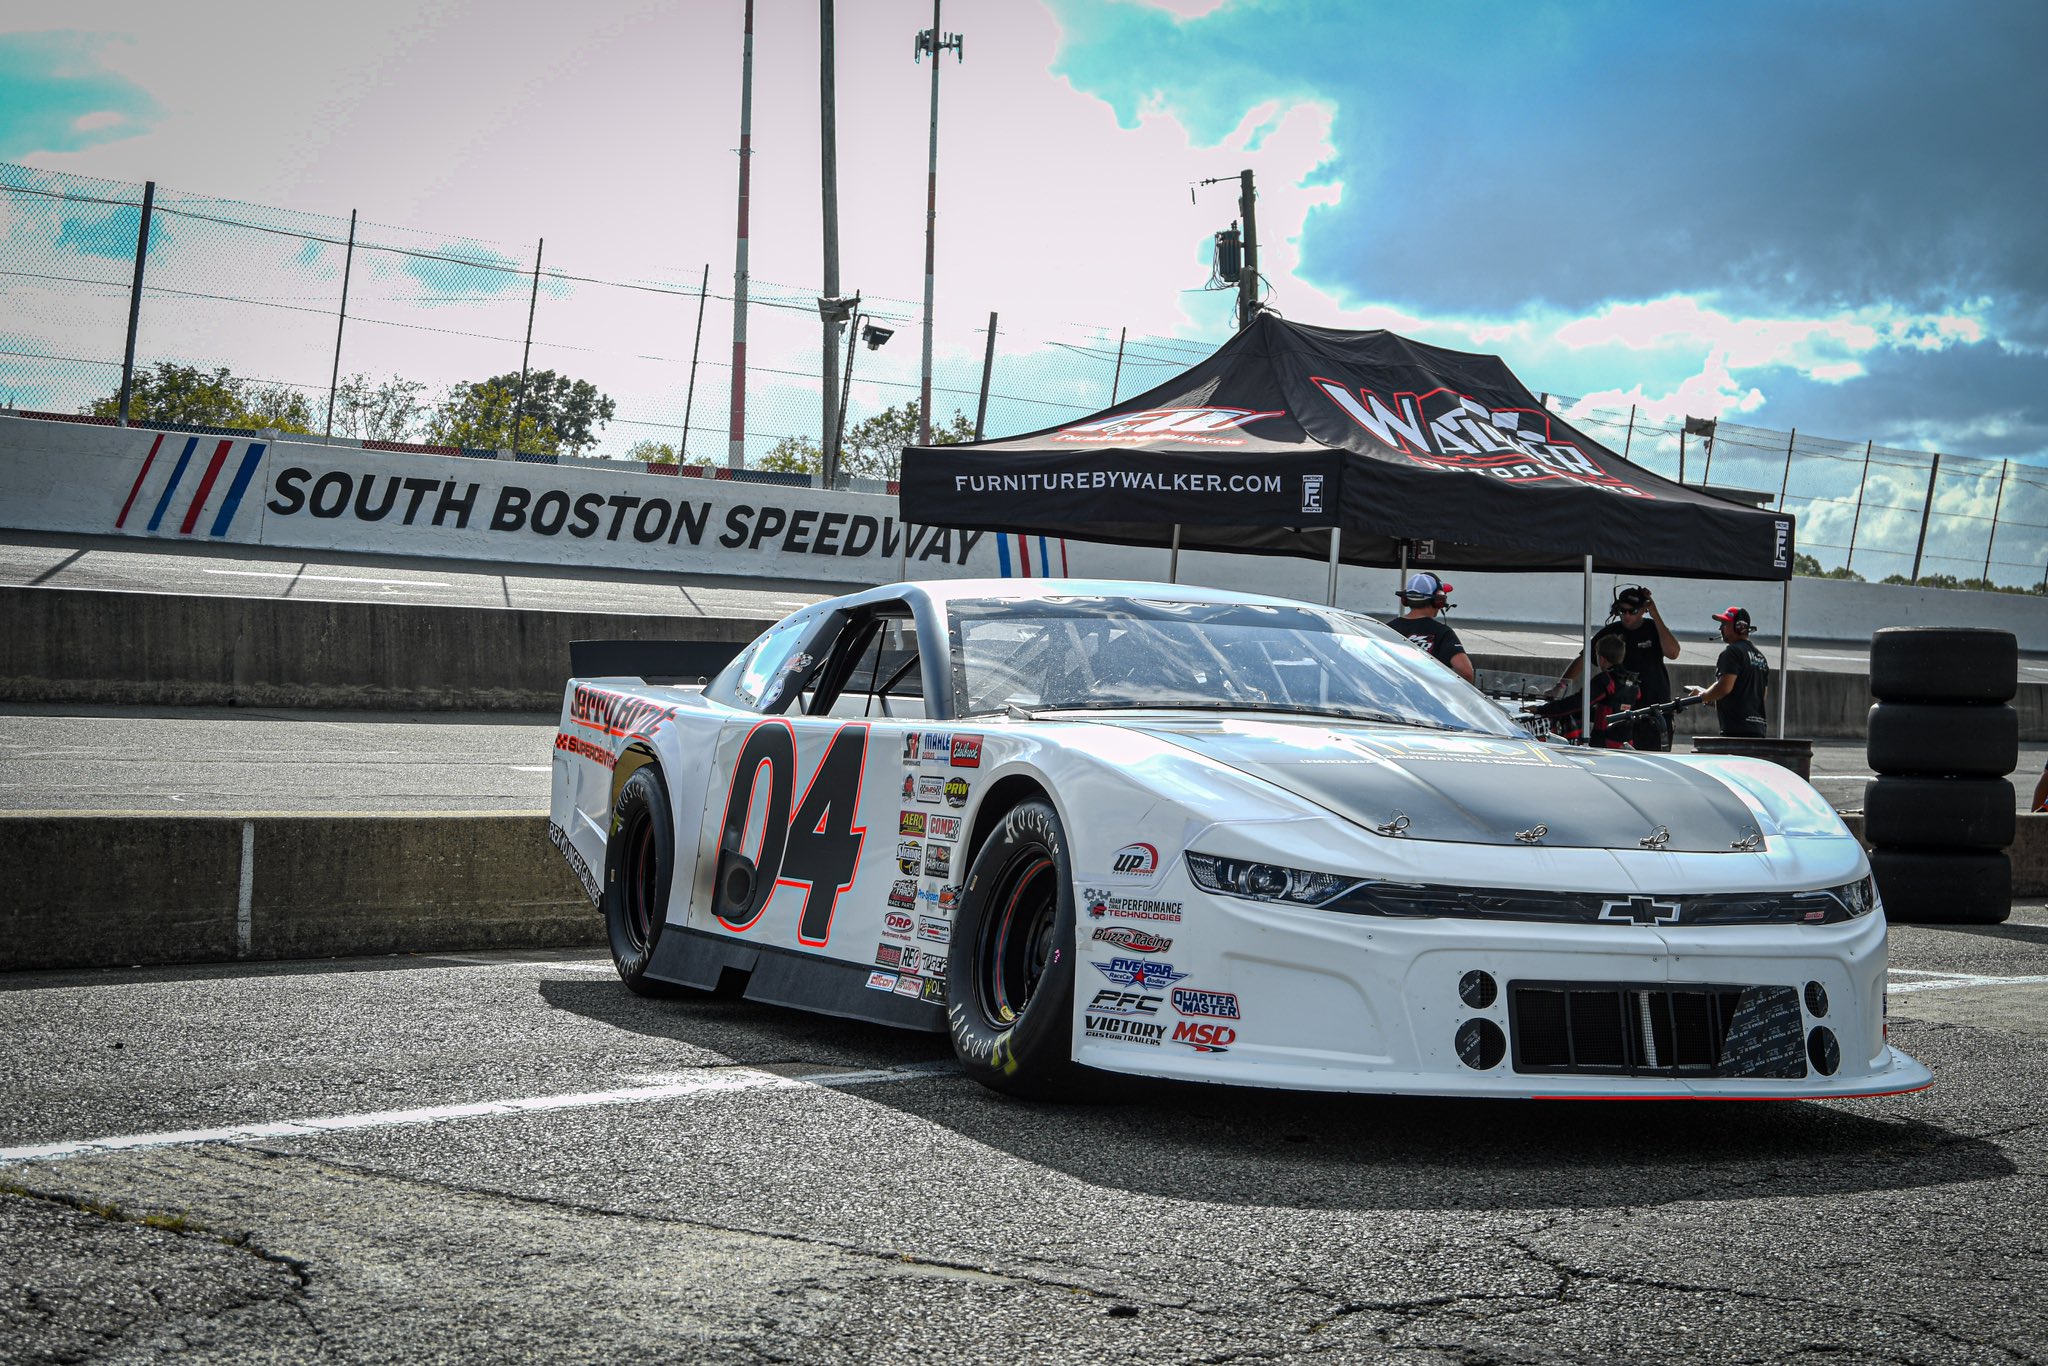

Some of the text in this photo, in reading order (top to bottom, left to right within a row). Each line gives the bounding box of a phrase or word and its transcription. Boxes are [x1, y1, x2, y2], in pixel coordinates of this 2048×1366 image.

[955, 471, 1281, 493] FURNITUREBYWALKER.COM
[267, 467, 984, 566] SOUTH BOSTON SPEEDWAY
[924, 733, 950, 750] MAHLE
[944, 782, 969, 795] PRW
[902, 813, 924, 830] AERO
[930, 817, 954, 835] COMP
[712, 718, 871, 947] 04
[1113, 854, 1145, 872] UP
[1121, 899, 1182, 914] PERFORMANCE
[887, 914, 911, 928] DRP
[1108, 910, 1181, 921] TECHNOLOGIES
[1092, 928, 1172, 952] Buzze Racing
[1110, 960, 1172, 978] FIVE STAR
[1091, 990, 1164, 1013] PFC
[1174, 990, 1235, 1006] QUARTER
[1088, 1004, 1128, 1012] BRAKES
[1182, 1001, 1237, 1017] MASTER
[1085, 1015, 1168, 1040] VICTORY
[1172, 1021, 1236, 1045] MSD
[1122, 1035, 1161, 1046] TRAILERS
